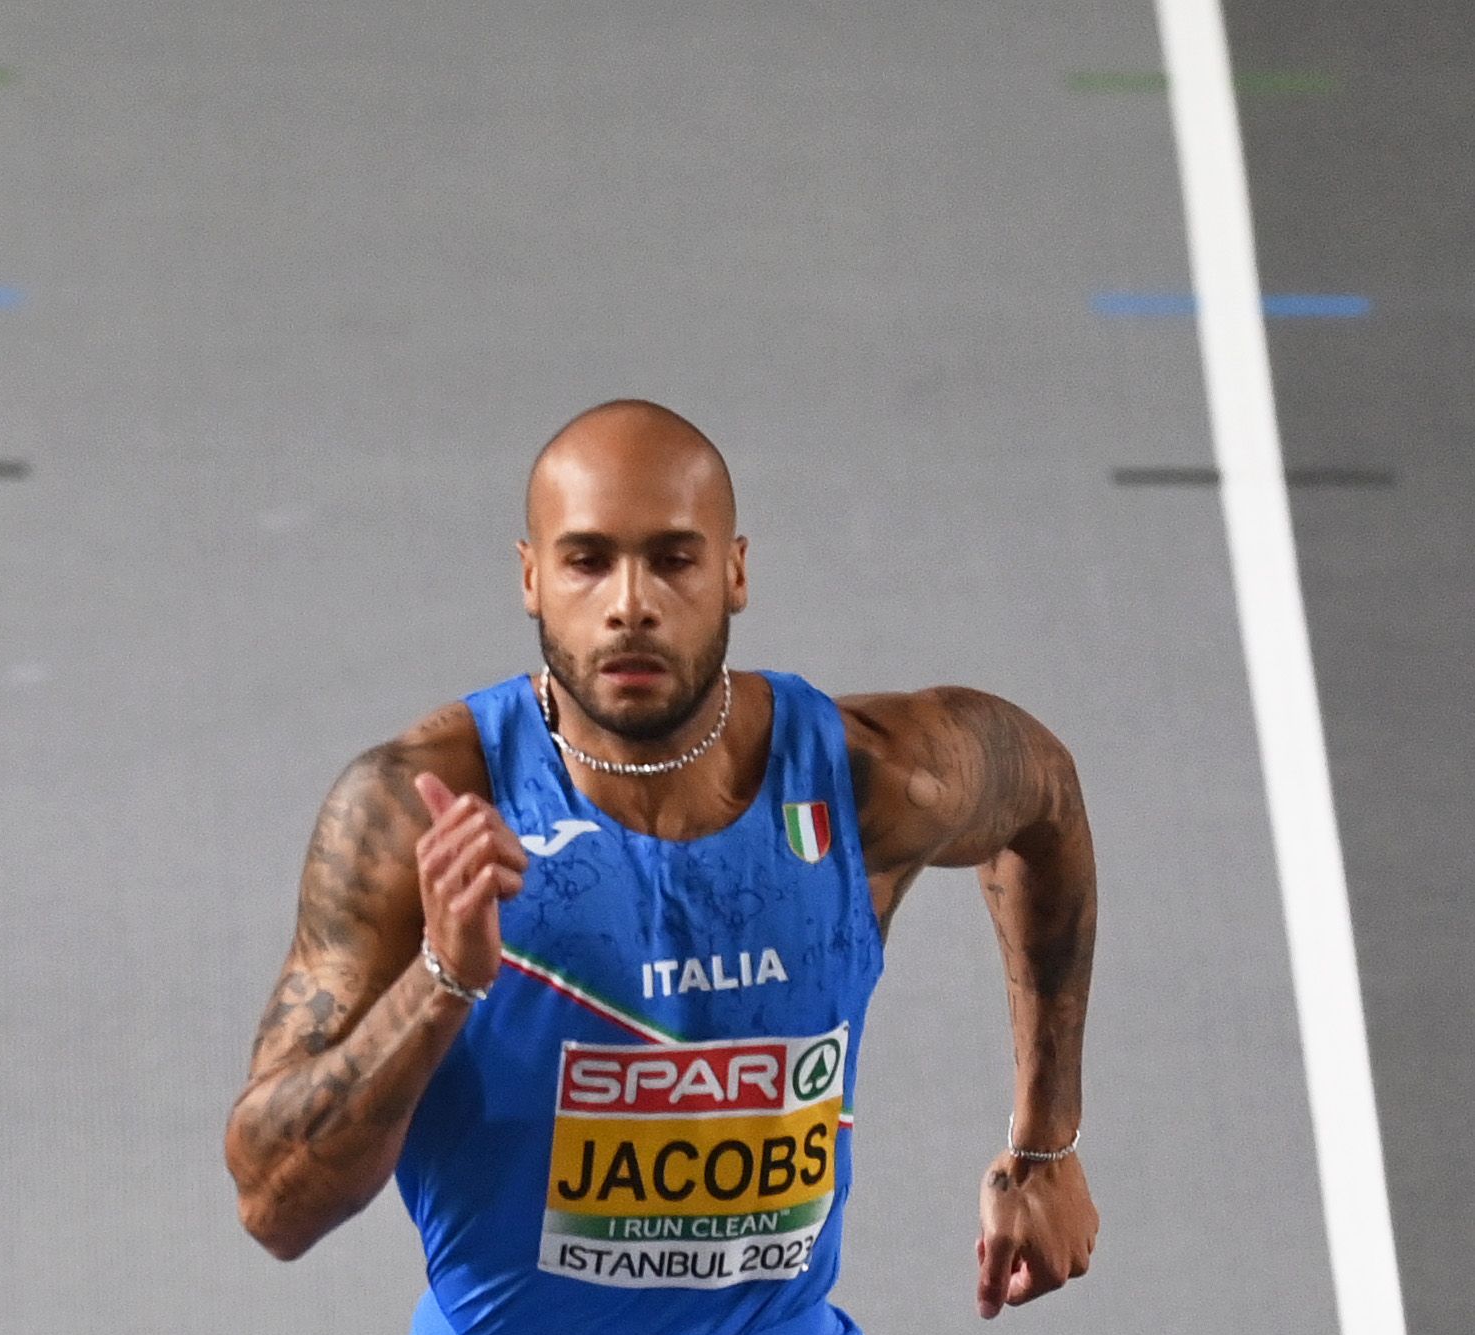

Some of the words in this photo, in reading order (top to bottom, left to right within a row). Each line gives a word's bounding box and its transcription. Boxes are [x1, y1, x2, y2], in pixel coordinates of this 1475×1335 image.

[642, 948, 788, 999] ITALIA
[569, 1054, 779, 1105] SPAR
[557, 1122, 827, 1202] JACOBS
[608, 1218, 616, 1237] I
[624, 1217, 683, 1238] RUN
[559, 1243, 733, 1279] ISTANBUL
